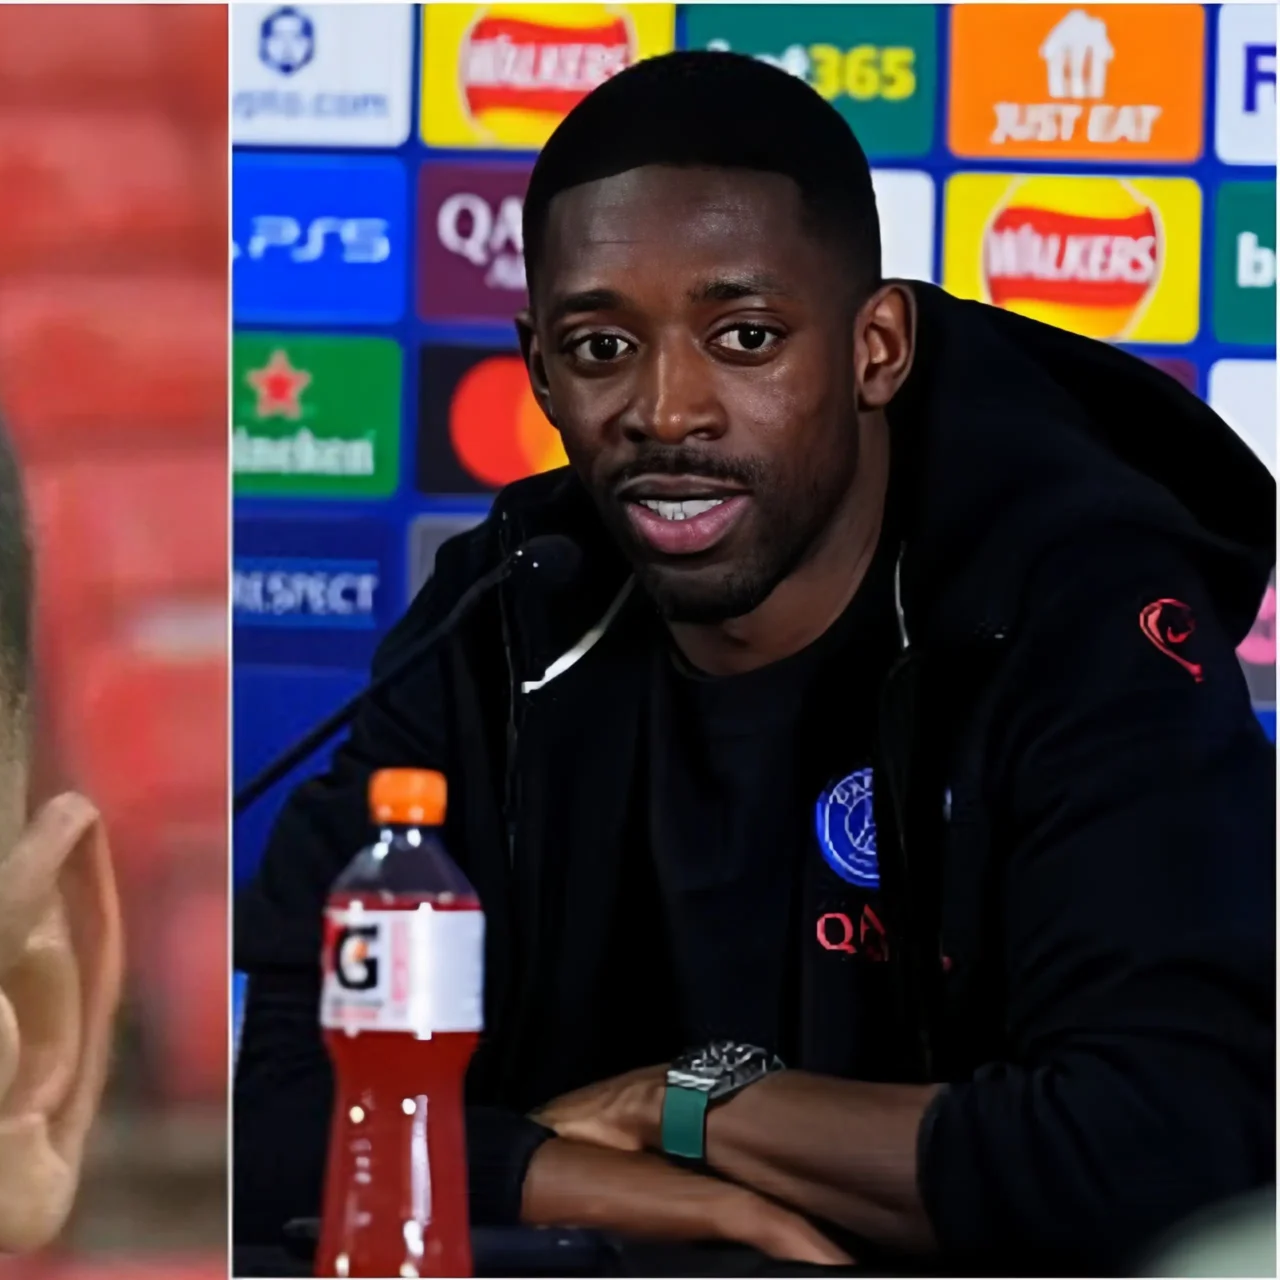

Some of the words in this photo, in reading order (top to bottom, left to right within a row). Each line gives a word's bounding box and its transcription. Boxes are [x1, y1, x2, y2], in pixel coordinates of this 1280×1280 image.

[990, 102, 1083, 144] JUST
[1087, 104, 1163, 143] EAT
[249, 214, 390, 264] PS5
[987, 222, 1157, 284] WALKERS
[335, 924, 379, 991] G
